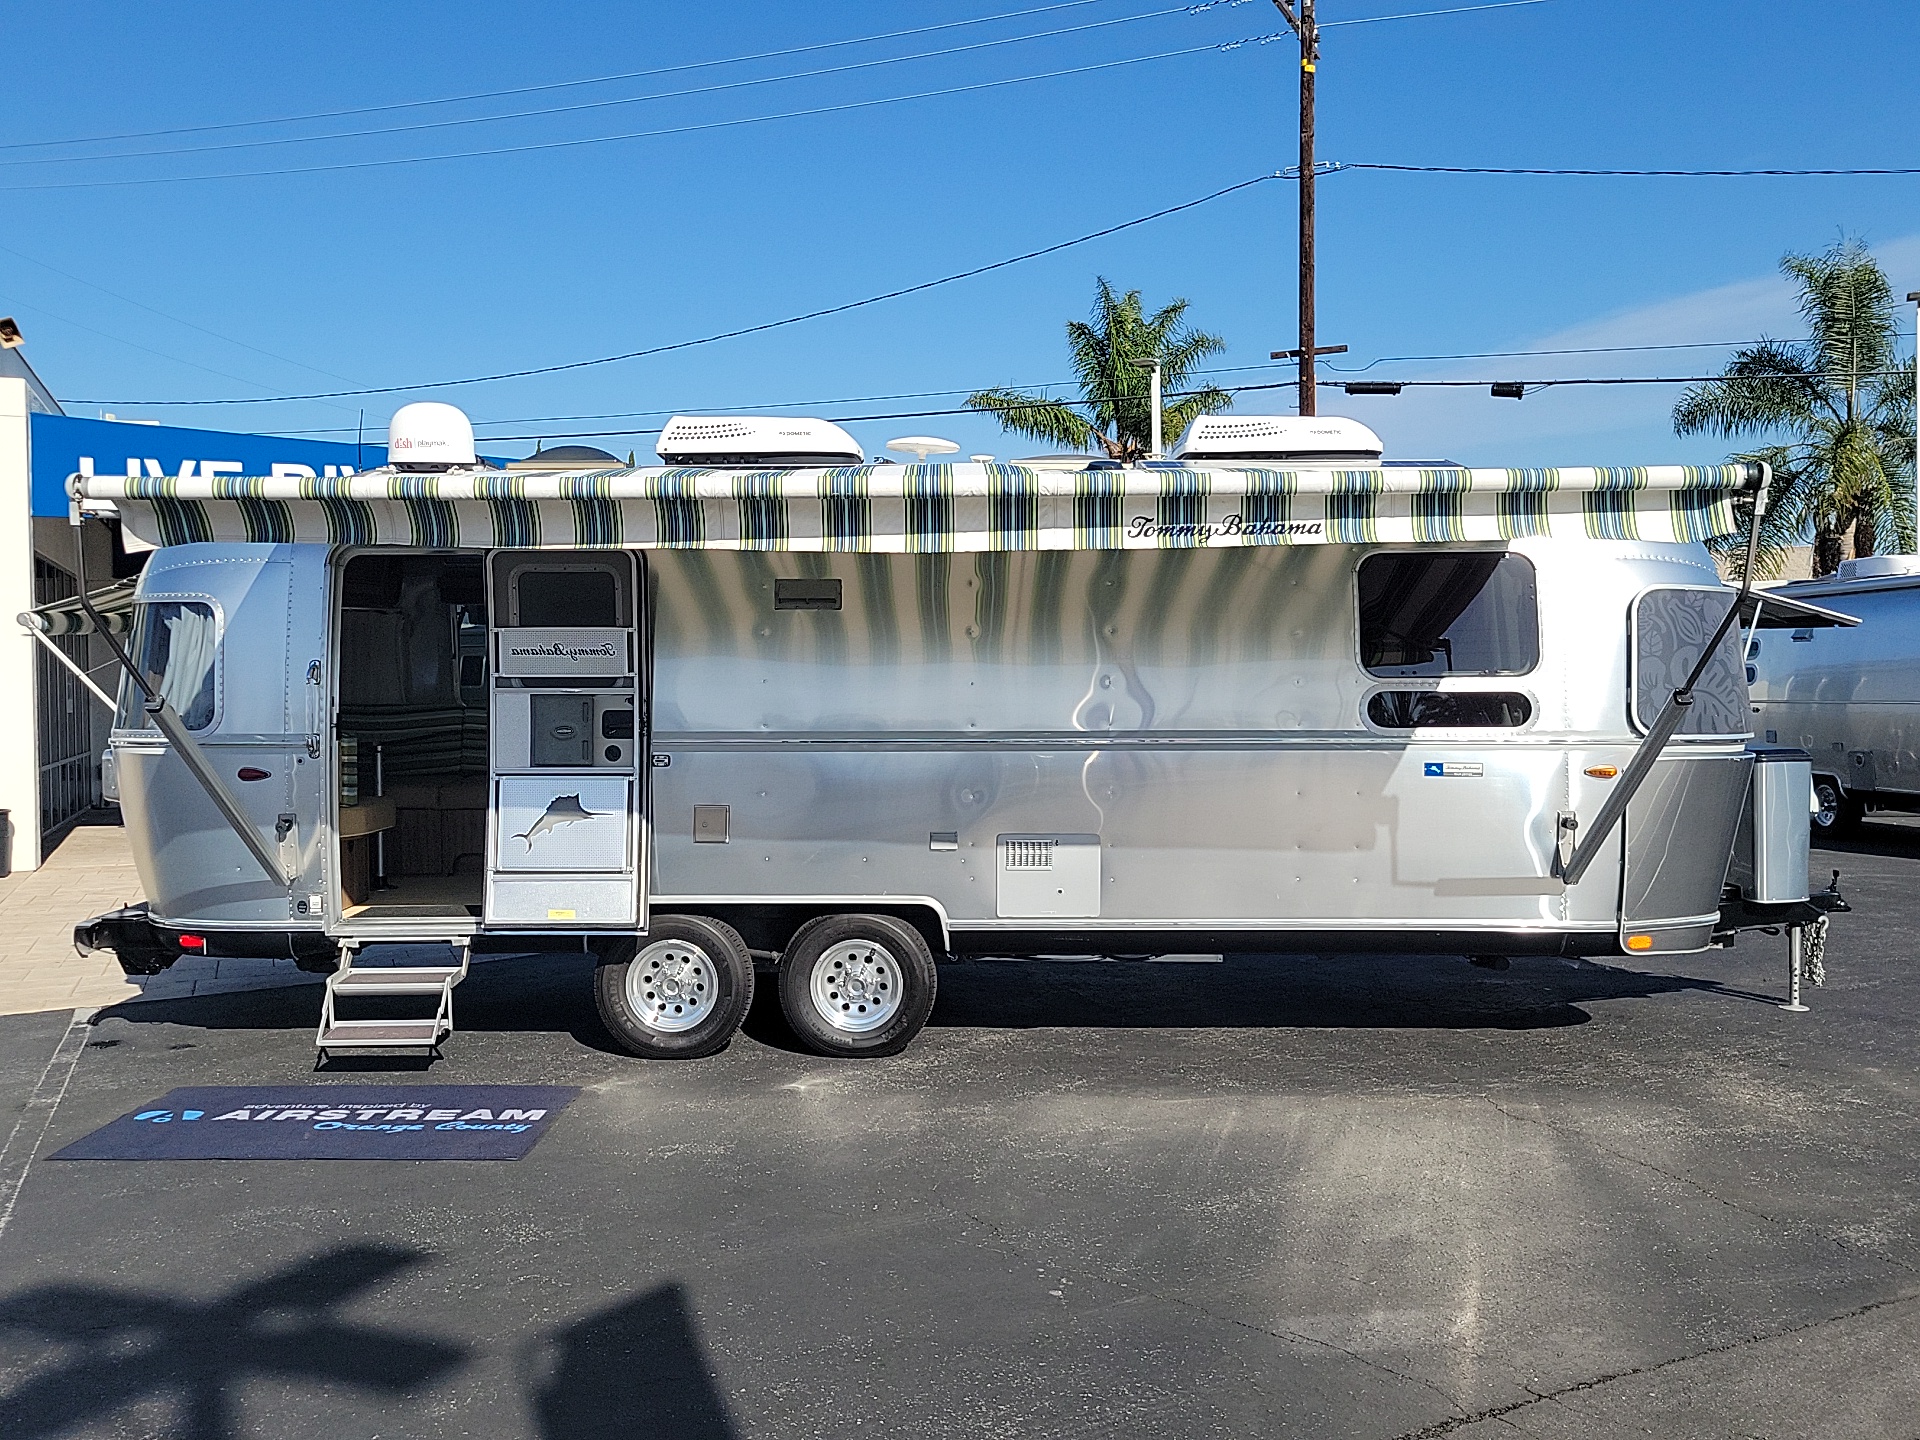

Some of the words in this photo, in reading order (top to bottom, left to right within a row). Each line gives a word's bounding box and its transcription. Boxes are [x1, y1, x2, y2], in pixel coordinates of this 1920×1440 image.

[408, 1102, 432, 1110] by
[211, 1109, 548, 1121] AIRSTREAM
[313, 1121, 424, 1133] Orange
[435, 1121, 532, 1133] County
